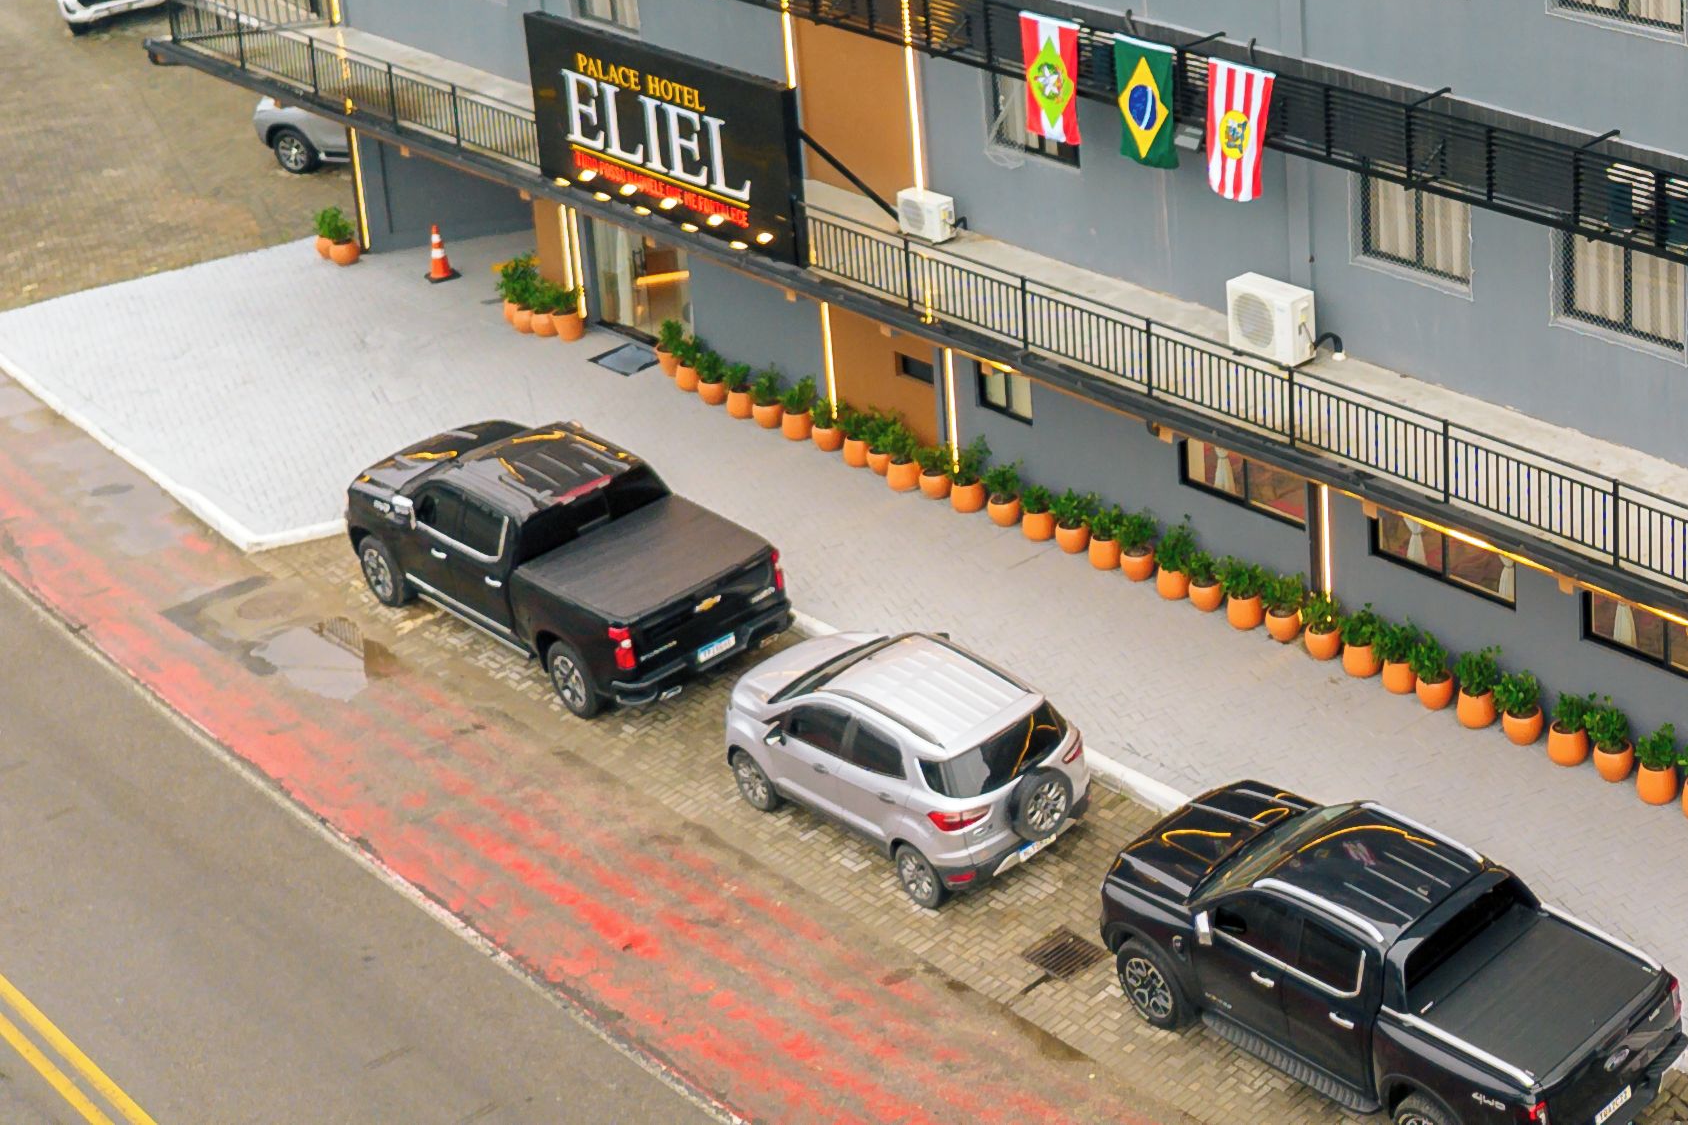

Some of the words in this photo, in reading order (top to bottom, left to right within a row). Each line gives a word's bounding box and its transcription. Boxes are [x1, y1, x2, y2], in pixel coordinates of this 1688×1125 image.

[576, 52, 641, 91] PALACE
[646, 74, 706, 111] HOTEL
[561, 68, 752, 201] ELIEL
[1472, 1092, 1506, 1111] 4WD
